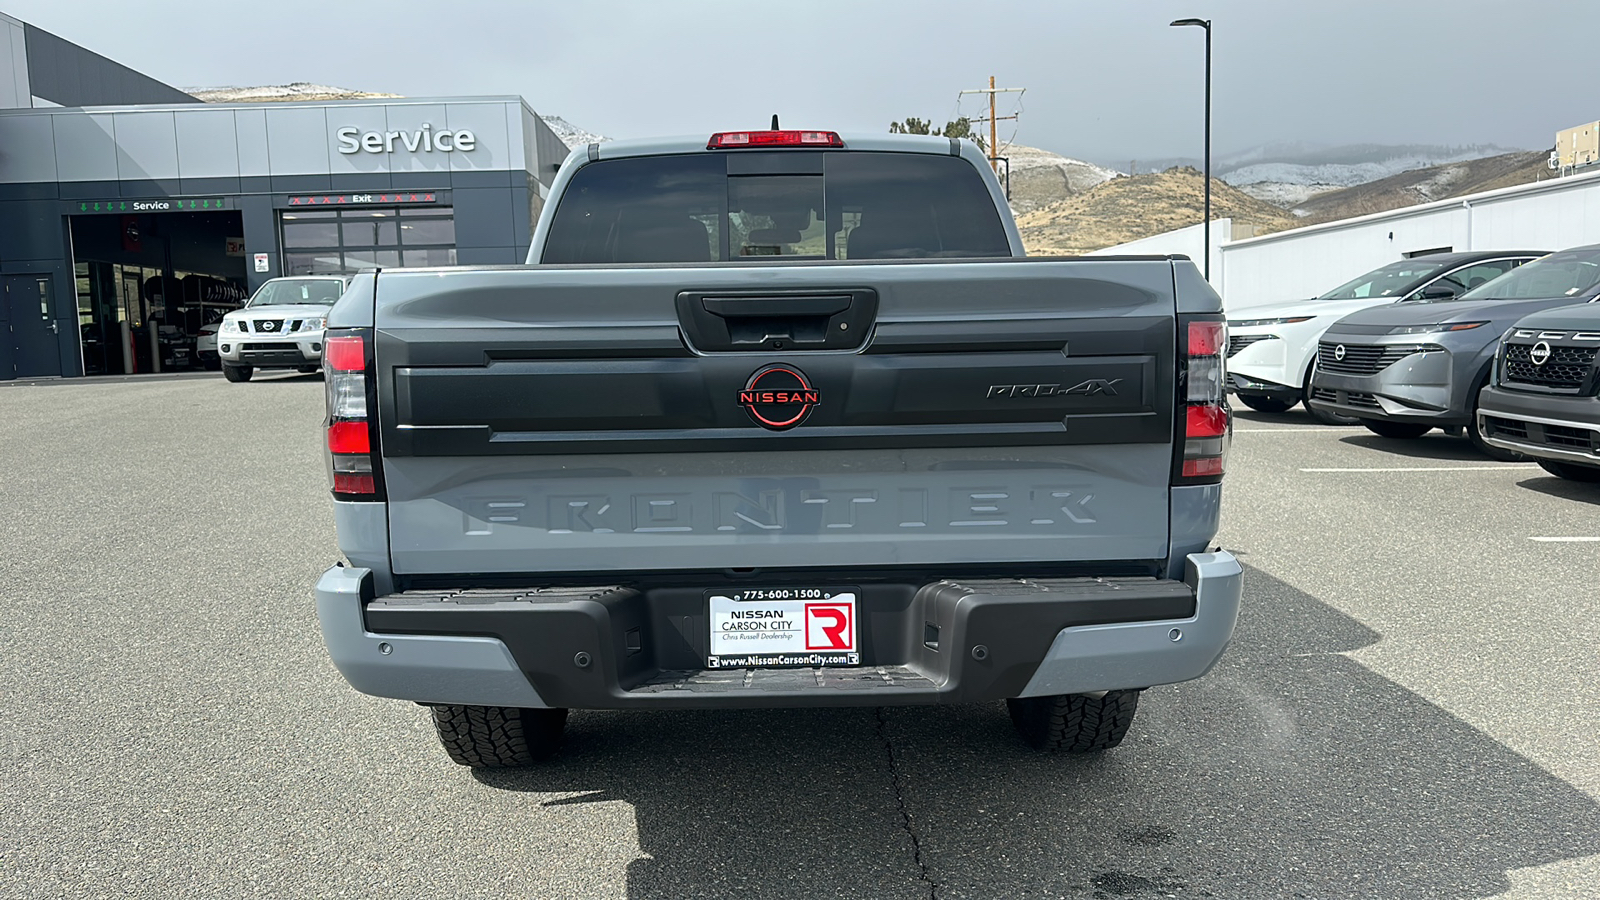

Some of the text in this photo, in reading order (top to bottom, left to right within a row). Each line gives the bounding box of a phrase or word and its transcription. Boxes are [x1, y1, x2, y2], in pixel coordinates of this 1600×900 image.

[336, 123, 476, 154] Service
[352, 194, 372, 202] Exit
[133, 201, 170, 210] Service
[741, 392, 817, 403] NISSAN
[462, 485, 1098, 536] FRONTIER
[743, 589, 821, 599] 775-600-1500
[731, 610, 784, 619] NISSAN
[722, 621, 793, 631] CARSON CITY
[722, 633, 738, 641] Chris
[761, 633, 793, 641] Dealership
[721, 655, 847, 666] www.NissanCarsonCity.com
